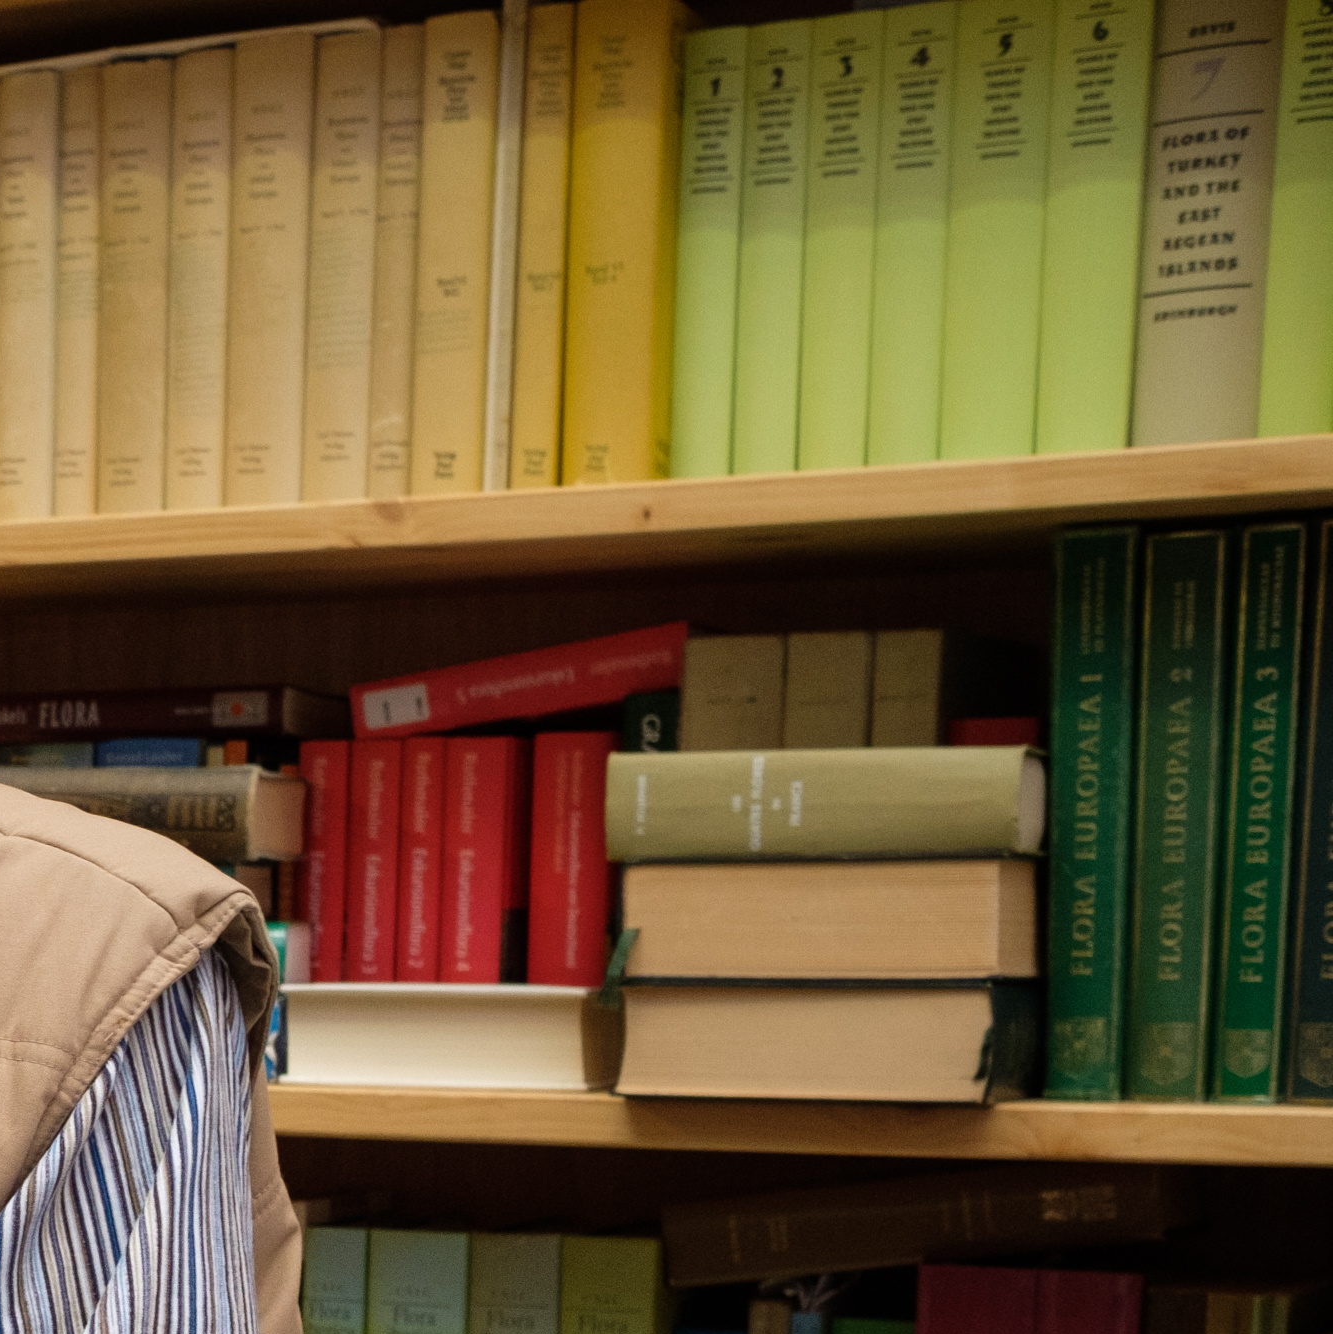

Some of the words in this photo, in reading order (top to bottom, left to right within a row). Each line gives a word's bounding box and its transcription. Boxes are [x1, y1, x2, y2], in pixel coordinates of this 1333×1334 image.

[1092, 20, 1110, 42] 6
[1192, 57, 1227, 101] 7
[1161, 128, 1220, 150] FLORA
[1224, 125, 1251, 142] OF
[1166, 152, 1242, 175] TURKEY
[1162, 183, 1200, 201] AND
[1205, 178, 1242, 196] THE
[1177, 205, 1223, 226] EAST
[1162, 230, 1237, 252] AEGEAN
[1157, 256, 1240, 279] ISLANDS
[1078, 671, 1103, 686] 1
[1170, 665, 1193, 685] 2
[1254, 665, 1279, 683] 3
[38, 699, 101, 732] FLORA
[1075, 691, 1103, 863] EUROPAEA
[1163, 695, 1193, 865] EUROPAEA
[1244, 689, 1278, 865] EUROPAEA
[1070, 873, 1098, 979] FLORA
[1156, 878, 1187, 983] FLORA
[1238, 878, 1270, 985] FLORA
[391, 1304, 437, 1328] Flora
[485, 1309, 537, 1331] Flora
